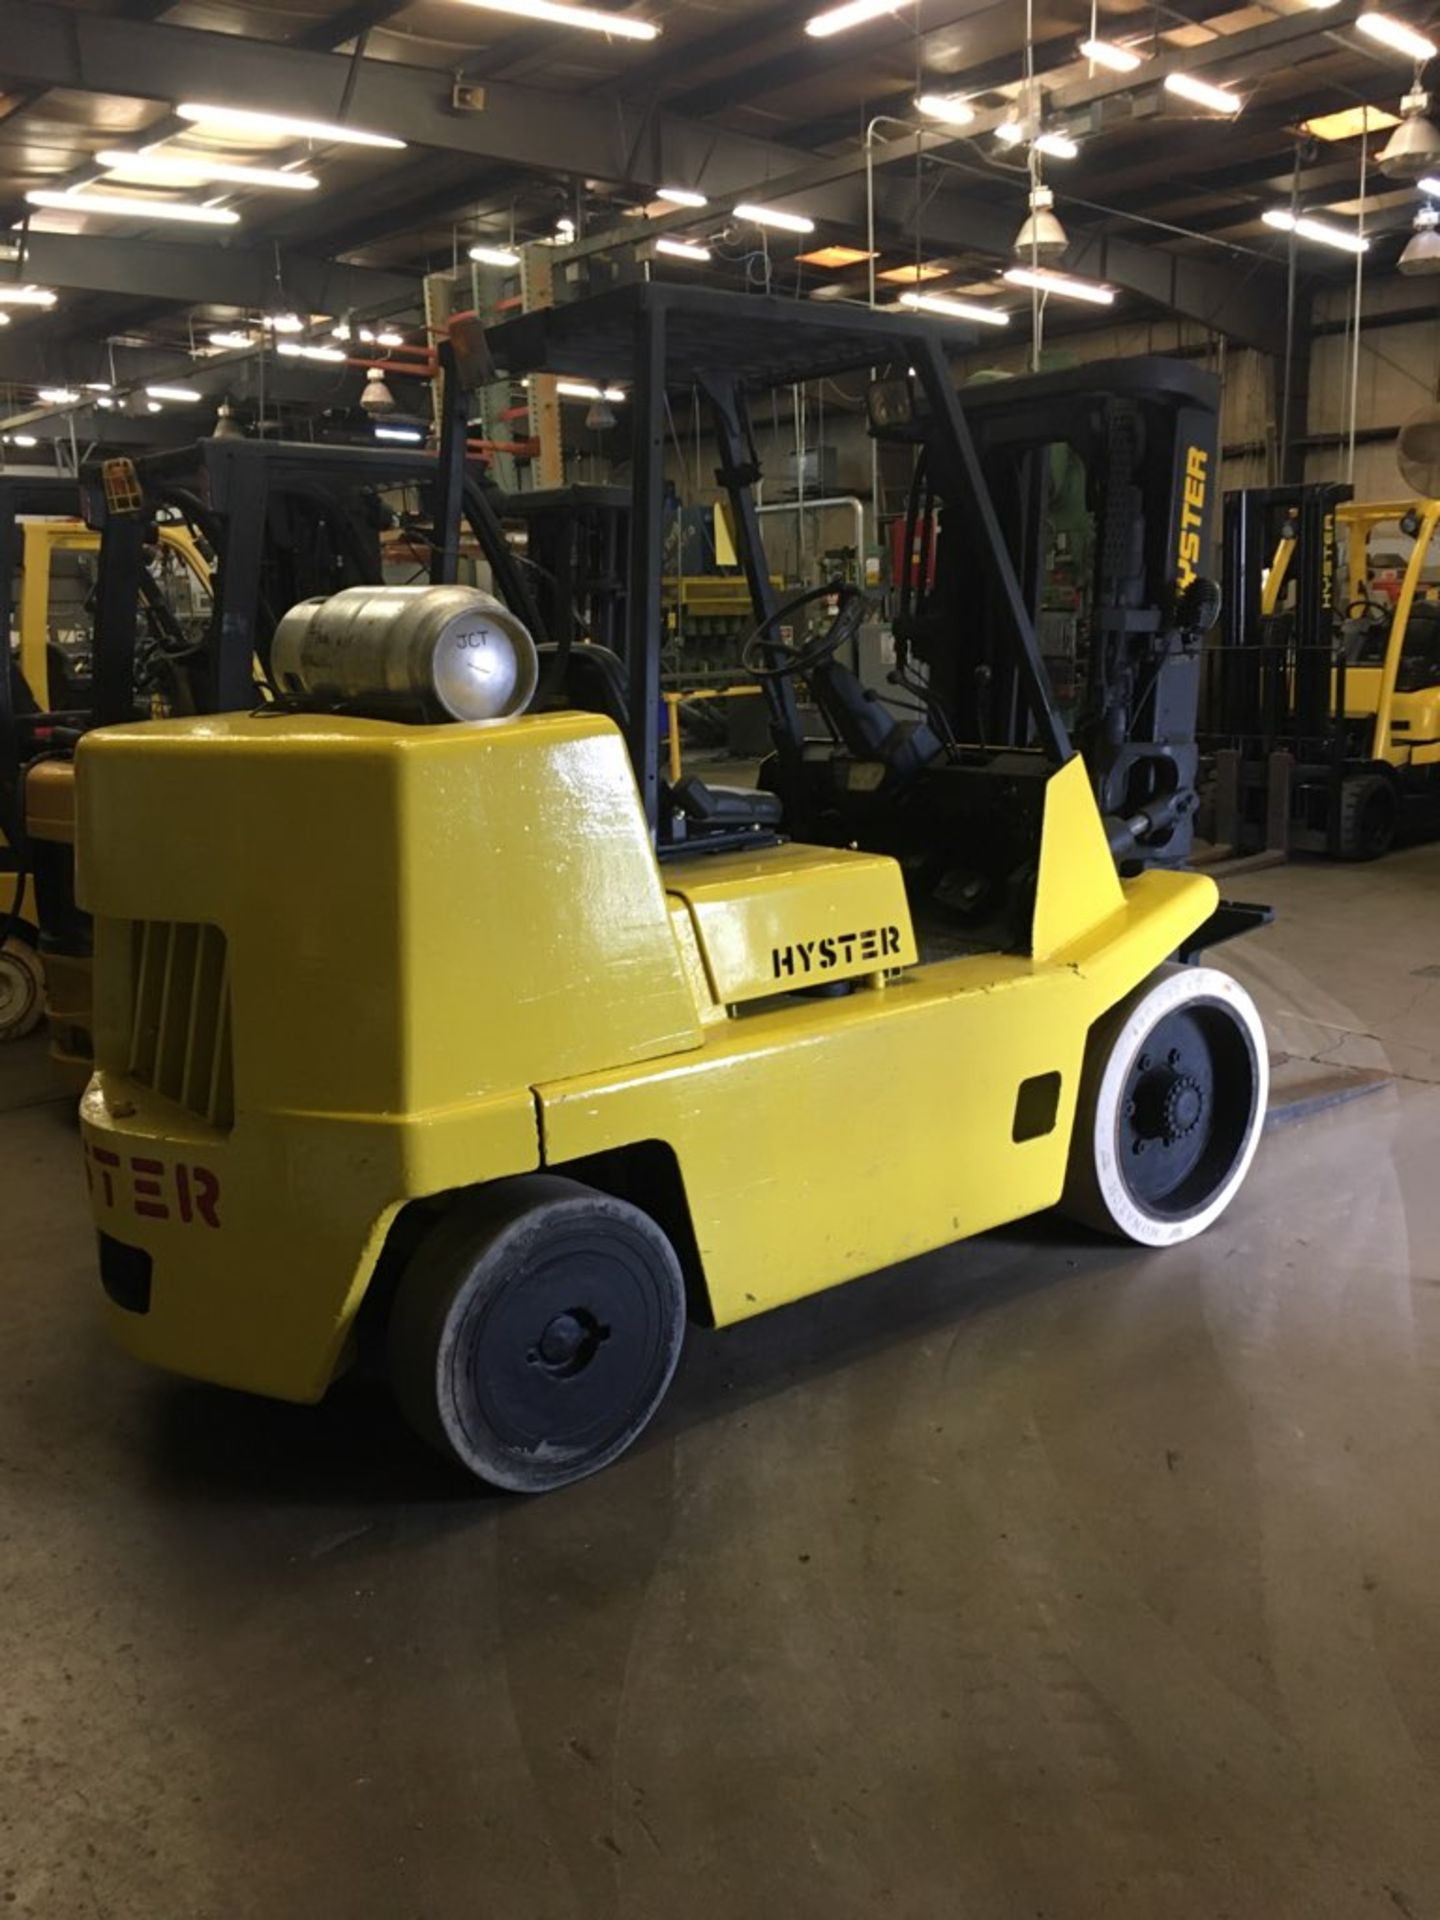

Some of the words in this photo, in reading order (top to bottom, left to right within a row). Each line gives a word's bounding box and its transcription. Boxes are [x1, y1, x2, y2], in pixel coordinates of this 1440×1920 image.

[1176, 446, 1208, 597] YSTER
[1322, 513, 1334, 609] HYSTER
[456, 629, 489, 649] JCT
[773, 926, 900, 978] HYSTER
[85, 1142, 221, 1228] TER
